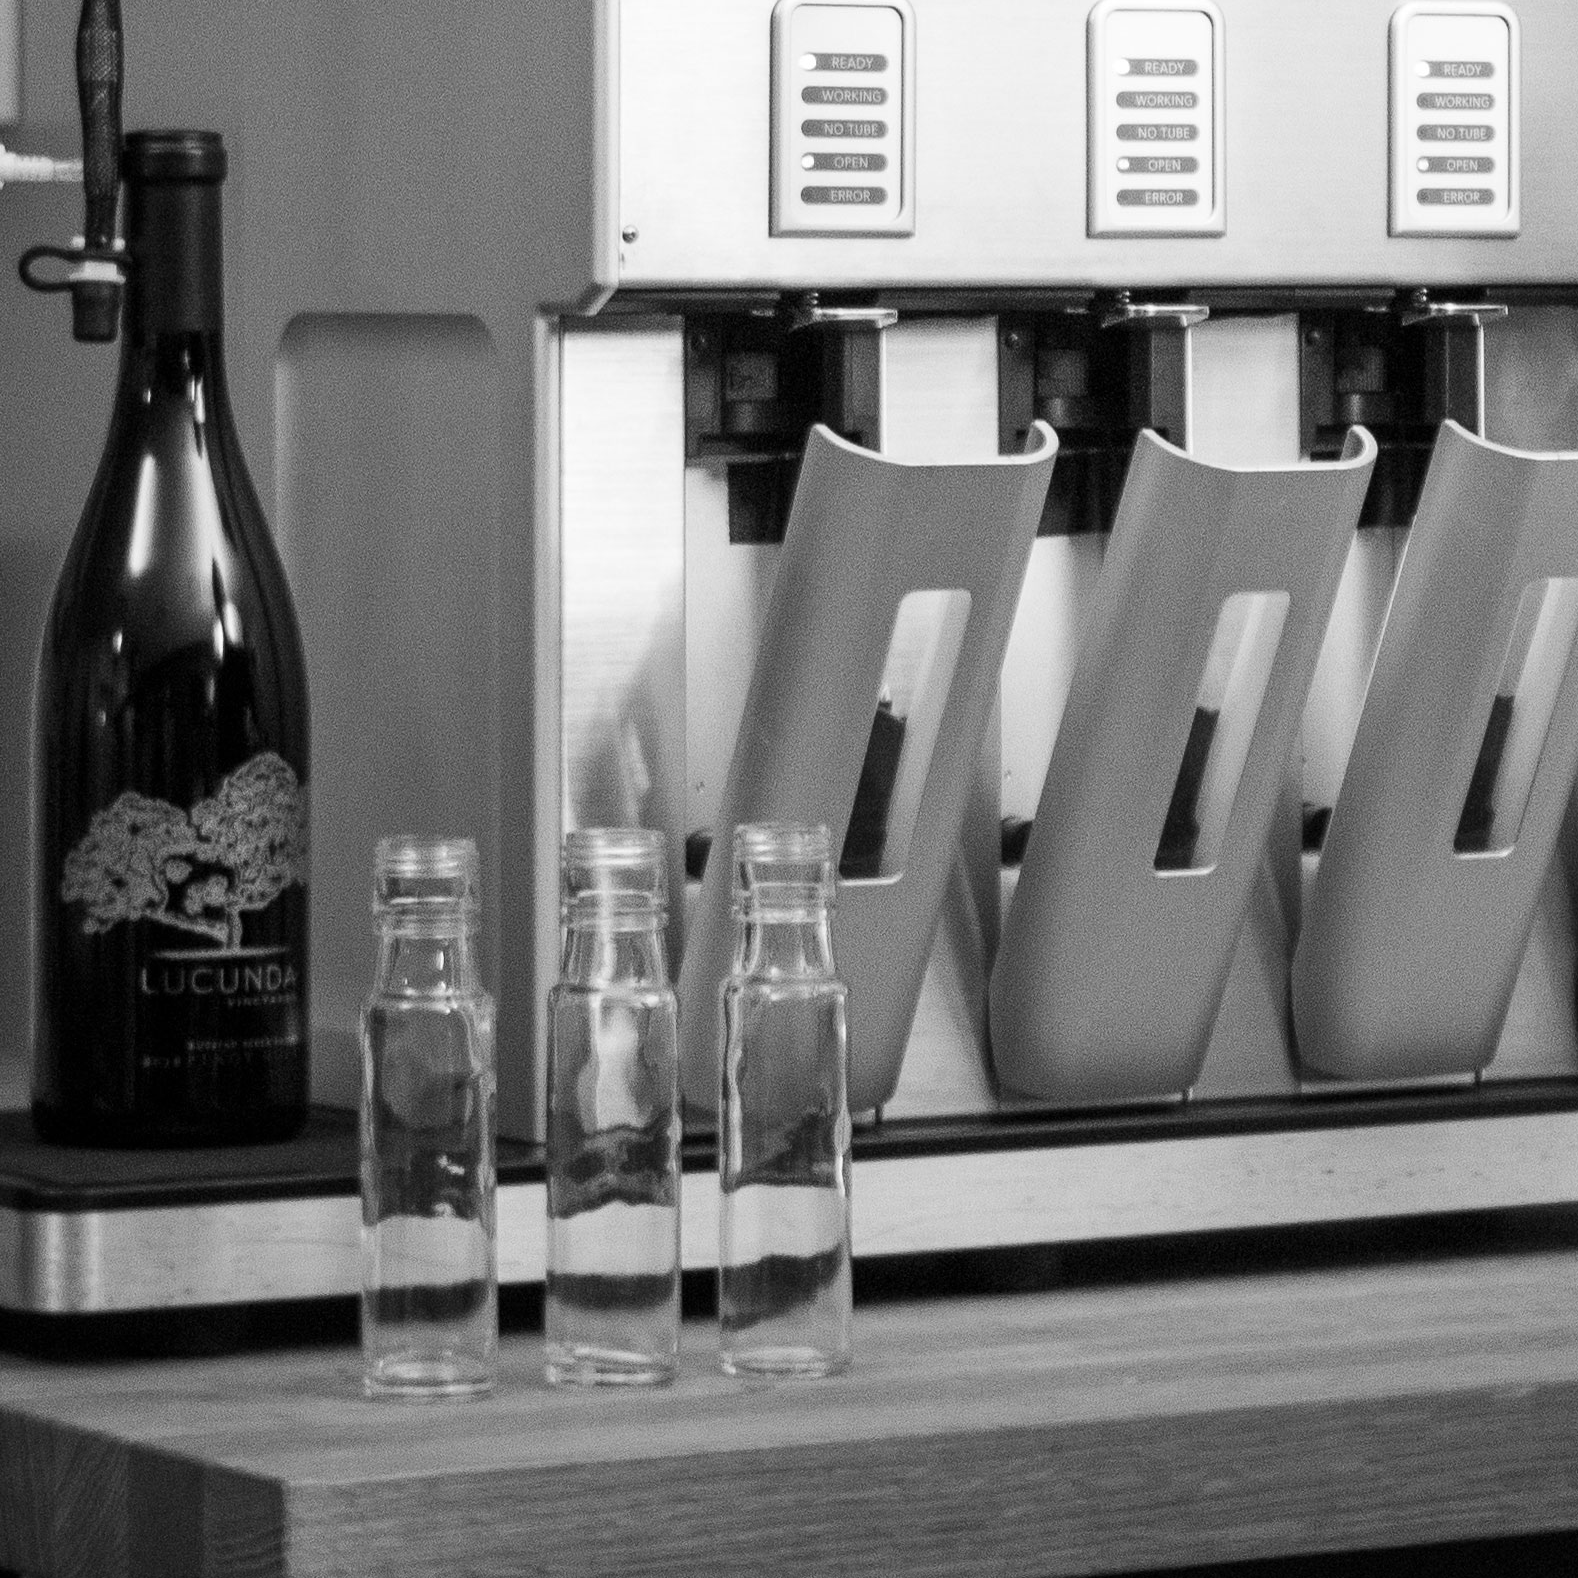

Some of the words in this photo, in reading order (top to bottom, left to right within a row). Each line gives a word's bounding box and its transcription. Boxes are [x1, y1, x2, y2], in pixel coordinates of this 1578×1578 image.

[831, 56, 874, 70] READY
[1144, 62, 1185, 75] READY
[1443, 64, 1482, 76] READY
[822, 89, 882, 103] WORKING
[1136, 95, 1193, 107] WORKING
[1435, 96, 1490, 108] WORKING
[824, 123, 843, 135] NO
[848, 122, 878, 136] TUBE
[1138, 127, 1157, 140] NO
[1160, 127, 1190, 140] TUBE
[1437, 127, 1455, 140] NO
[1458, 127, 1487, 140] TUBE
[834, 156, 868, 169] OPEN
[1148, 159, 1181, 171] OPEN
[1446, 159, 1478, 171] OPEN
[831, 189, 870, 202] ERROR
[1145, 191, 1184, 204] ERROR
[1443, 191, 1480, 204] ERROR
